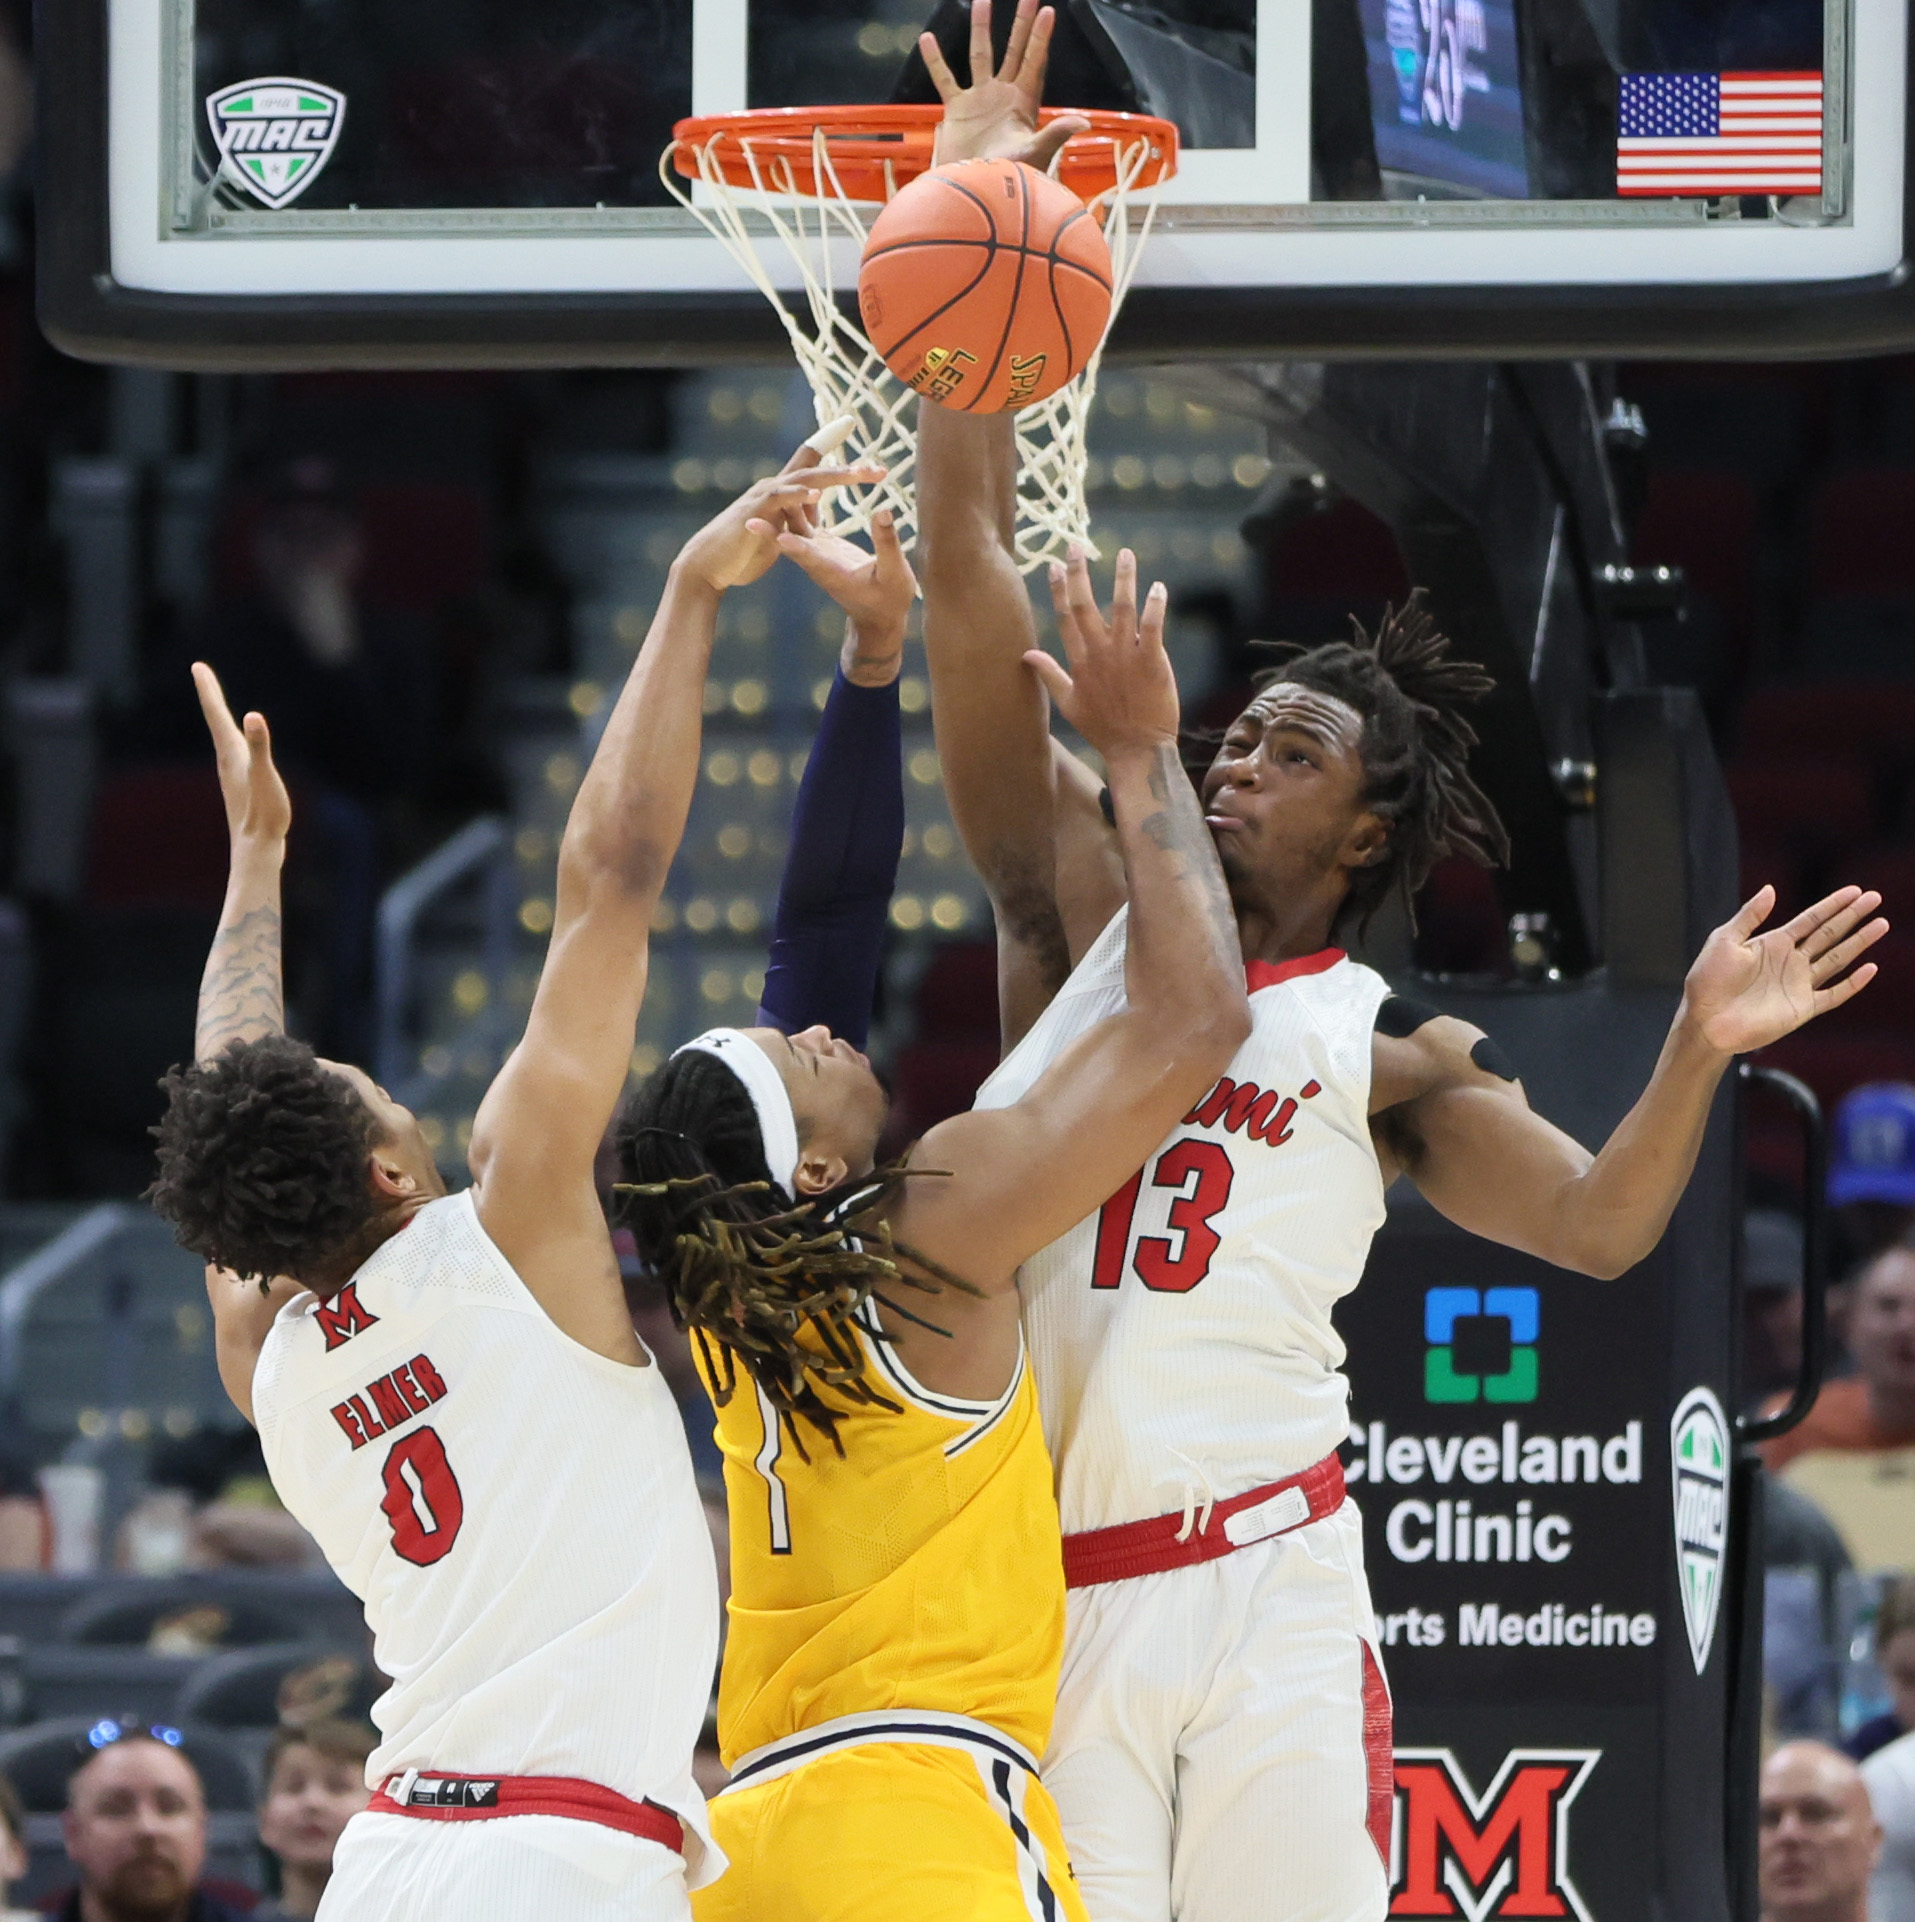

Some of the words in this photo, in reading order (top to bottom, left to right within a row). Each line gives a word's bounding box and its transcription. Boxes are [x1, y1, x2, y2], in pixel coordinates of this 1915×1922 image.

[220, 120, 331, 150] MAC
[1090, 1137, 1235, 1293] 13
[329, 1352, 448, 1452] ELMER
[379, 1424, 464, 1568] 0
[1386, 1499, 1573, 1563] Clinic
[1374, 1604, 1446, 1647] rts
[1458, 1603, 1657, 1647] Medicine
[1389, 1748, 1602, 1922] M
